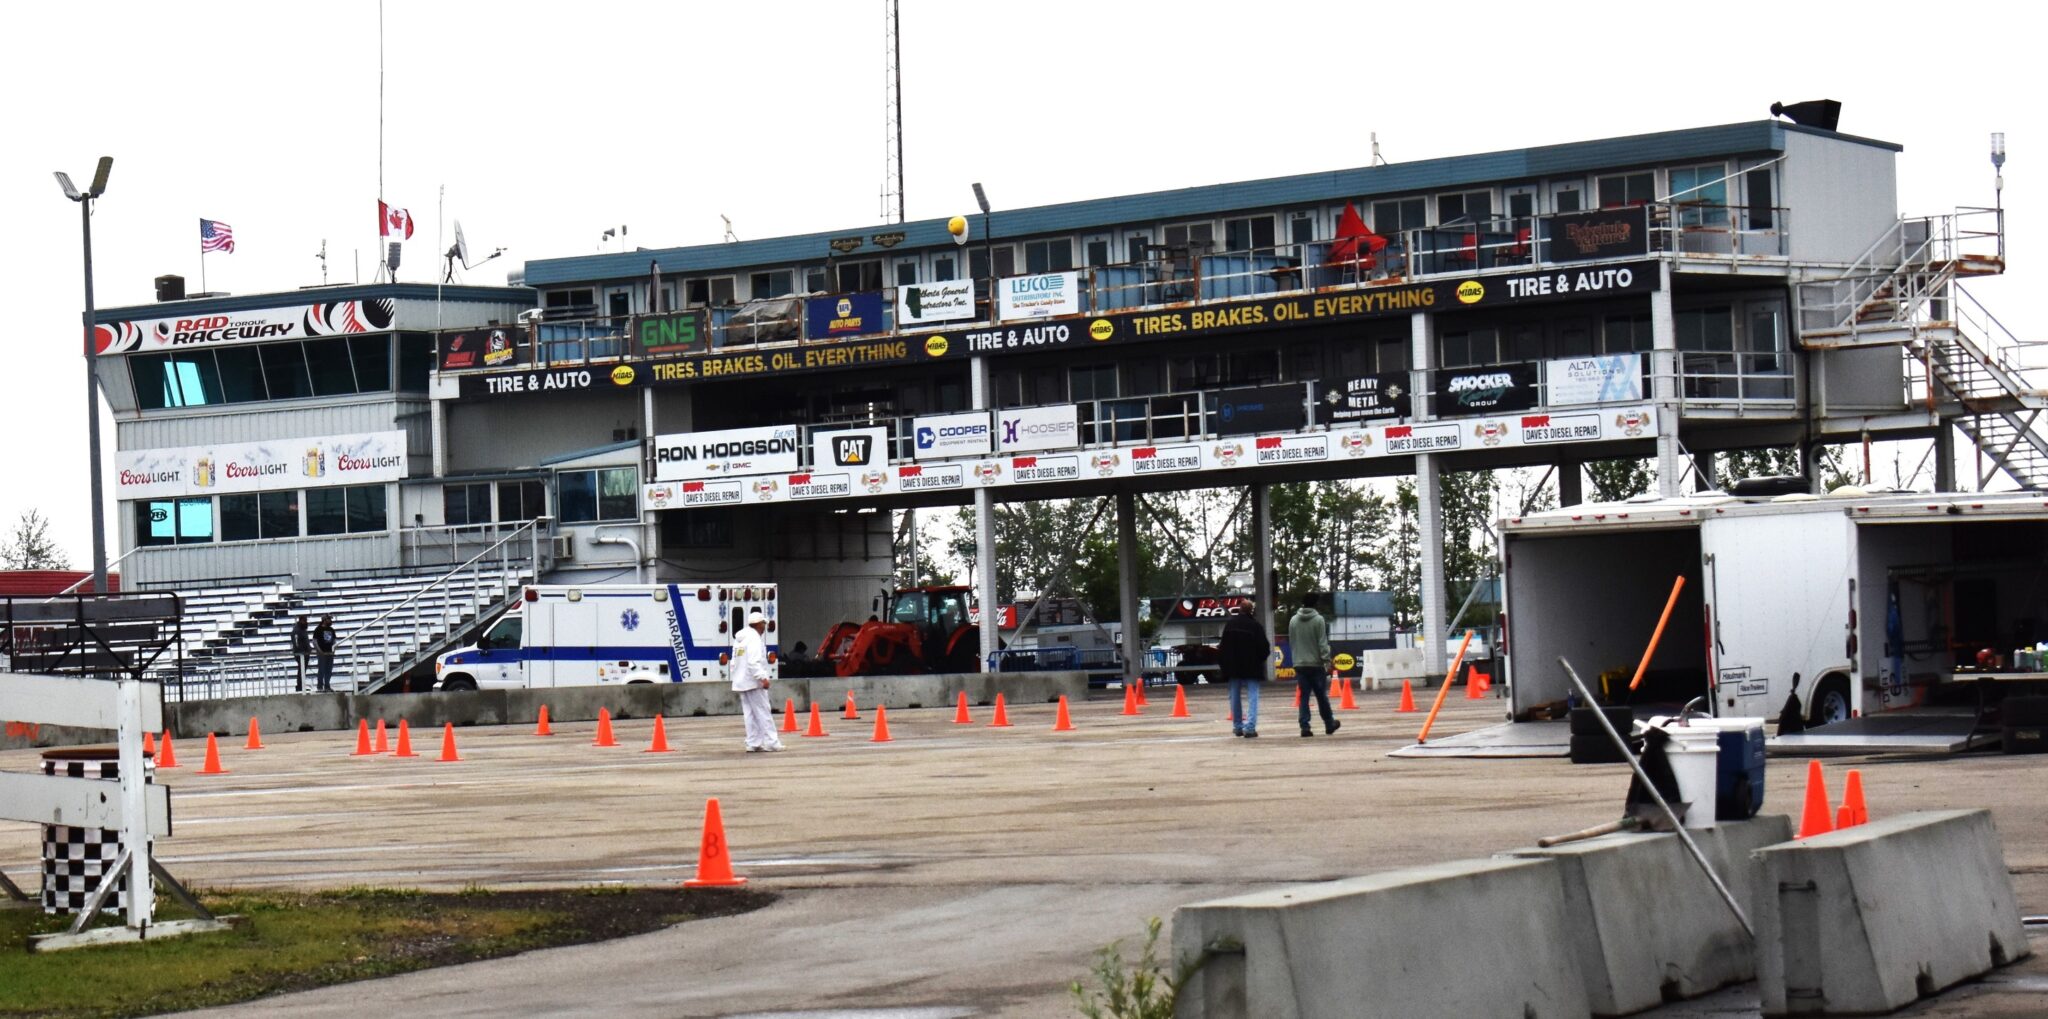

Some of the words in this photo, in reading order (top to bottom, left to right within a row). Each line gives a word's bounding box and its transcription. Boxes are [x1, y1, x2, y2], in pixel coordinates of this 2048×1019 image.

[1012, 276, 1050, 293] LESCO
[1507, 277, 1552, 297] TIRE
[1556, 274, 1570, 292] &
[1575, 269, 1633, 291] AUTO
[942, 286, 969, 299] General
[920, 299, 953, 310] ontractors
[1133, 315, 1187, 336] TIRES.
[1192, 306, 1268, 330] BRAKES.
[1274, 302, 1309, 321] OIL.
[1314, 287, 1435, 316] EVERYTHING
[175, 315, 229, 333] RAD
[229, 318, 267, 328] TORQUE
[829, 318, 844, 329] AUTO
[844, 317, 862, 328] PARTS
[173, 322, 296, 345] RACEWAY
[642, 316, 697, 347] GNS
[966, 333, 1003, 350] TIRE
[1007, 331, 1019, 346] &
[1022, 325, 1070, 346] AUTO
[652, 361, 699, 380] TIRES.
[703, 355, 768, 376] BRAKES.
[773, 351, 802, 370] OIL.
[806, 342, 907, 367] EVERYTHING
[486, 375, 524, 395] TIRE
[528, 376, 540, 391] &
[543, 371, 592, 390] AUTO
[1348, 378, 1378, 392] HEAVY
[1448, 373, 1515, 393] SHOCKER
[1348, 395, 1379, 408] METAL
[1470, 400, 1498, 408] GROUP
[940, 425, 987, 437] COOPER
[1021, 421, 1075, 435] HOOSIER
[1526, 428, 1548, 441] DAVE'S
[1550, 427, 1573, 439] DIESEL
[1574, 425, 1598, 437] REPAIR
[658, 444, 697, 462] RON
[703, 437, 796, 459] HODGSON
[840, 439, 865, 463] CAT
[1390, 439, 1411, 450] DAVE'S
[1413, 437, 1434, 448] DIESEL
[1436, 436, 1458, 447] REPAIR
[1260, 449, 1280, 461] DAVE'S
[1282, 448, 1303, 459] DIESEL
[1304, 446, 1325, 457] REPAIR
[226, 461, 259, 478] Coors
[260, 463, 288, 476] LIGHT
[338, 455, 372, 471] Coors
[372, 456, 401, 468] LIGHT
[1136, 460, 1155, 470] DAVE'S
[1157, 458, 1177, 469] DIESEL
[1178, 456, 1198, 467] REPAIR
[120, 469, 152, 486] Coors
[152, 471, 181, 484] LIGHT
[1017, 469, 1035, 480] DAVE'S
[1037, 468, 1056, 478] DIESEL
[1057, 466, 1077, 476] REPAIR
[792, 485, 809, 496] DAVE'S
[811, 484, 828, 495] DIESEL
[830, 483, 848, 493] REPAIR
[903, 478, 921, 488] DAVE'S
[922, 477, 940, 486] DIESEL
[941, 475, 960, 485] REPAIR
[686, 492, 703, 503] DAVE'S
[705, 491, 722, 502] DIESEL
[722, 490, 740, 500] REPAIR
[665, 609, 691, 680] PARAMEDIC
[704, 831, 719, 860] 8
